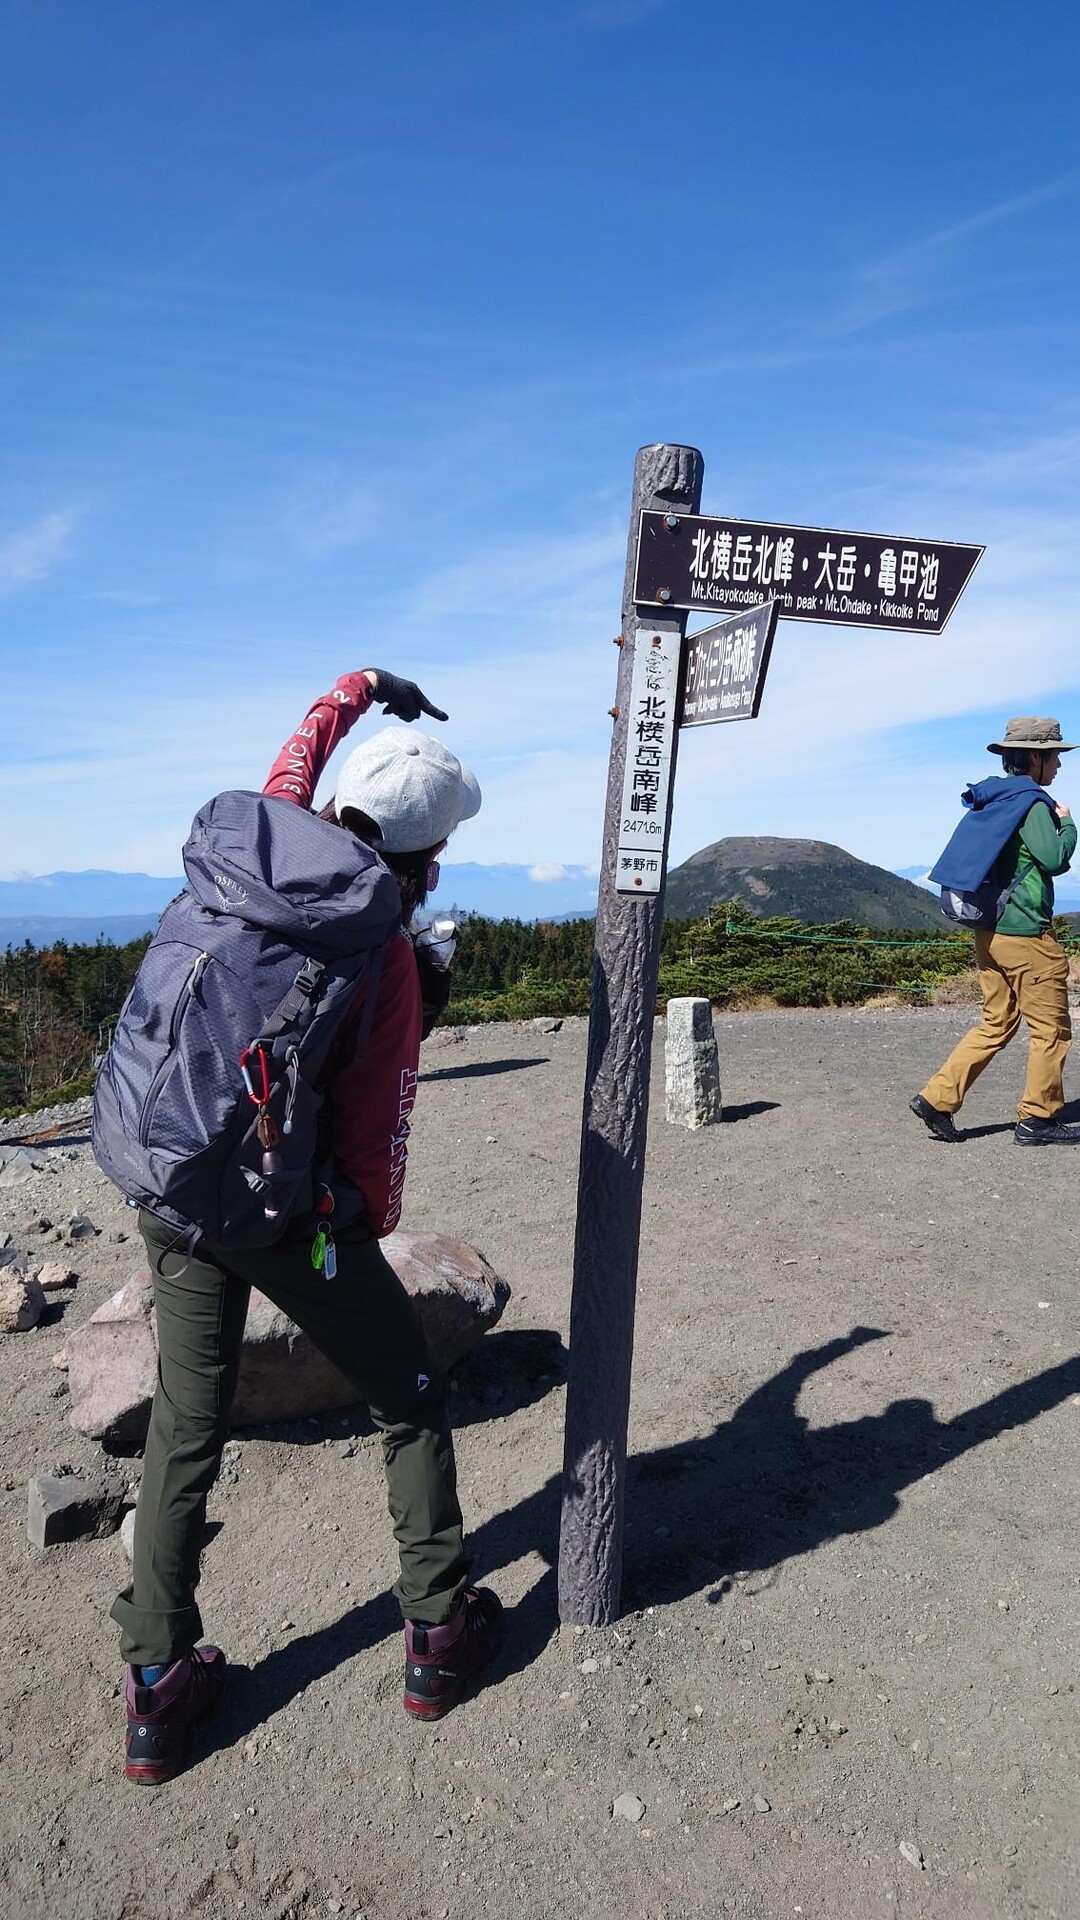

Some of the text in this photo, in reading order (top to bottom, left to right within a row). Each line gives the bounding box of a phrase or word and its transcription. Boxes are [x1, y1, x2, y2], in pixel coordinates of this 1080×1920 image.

[796, 595, 817, 611] peak
[917, 602, 940, 622] Pond
[282, 727, 315, 795] SINCE
[630, 696, 666, 815] 北横岳南峰
[620, 857, 659, 872] 茅野市
[214, 875, 250, 898] OSPREY
